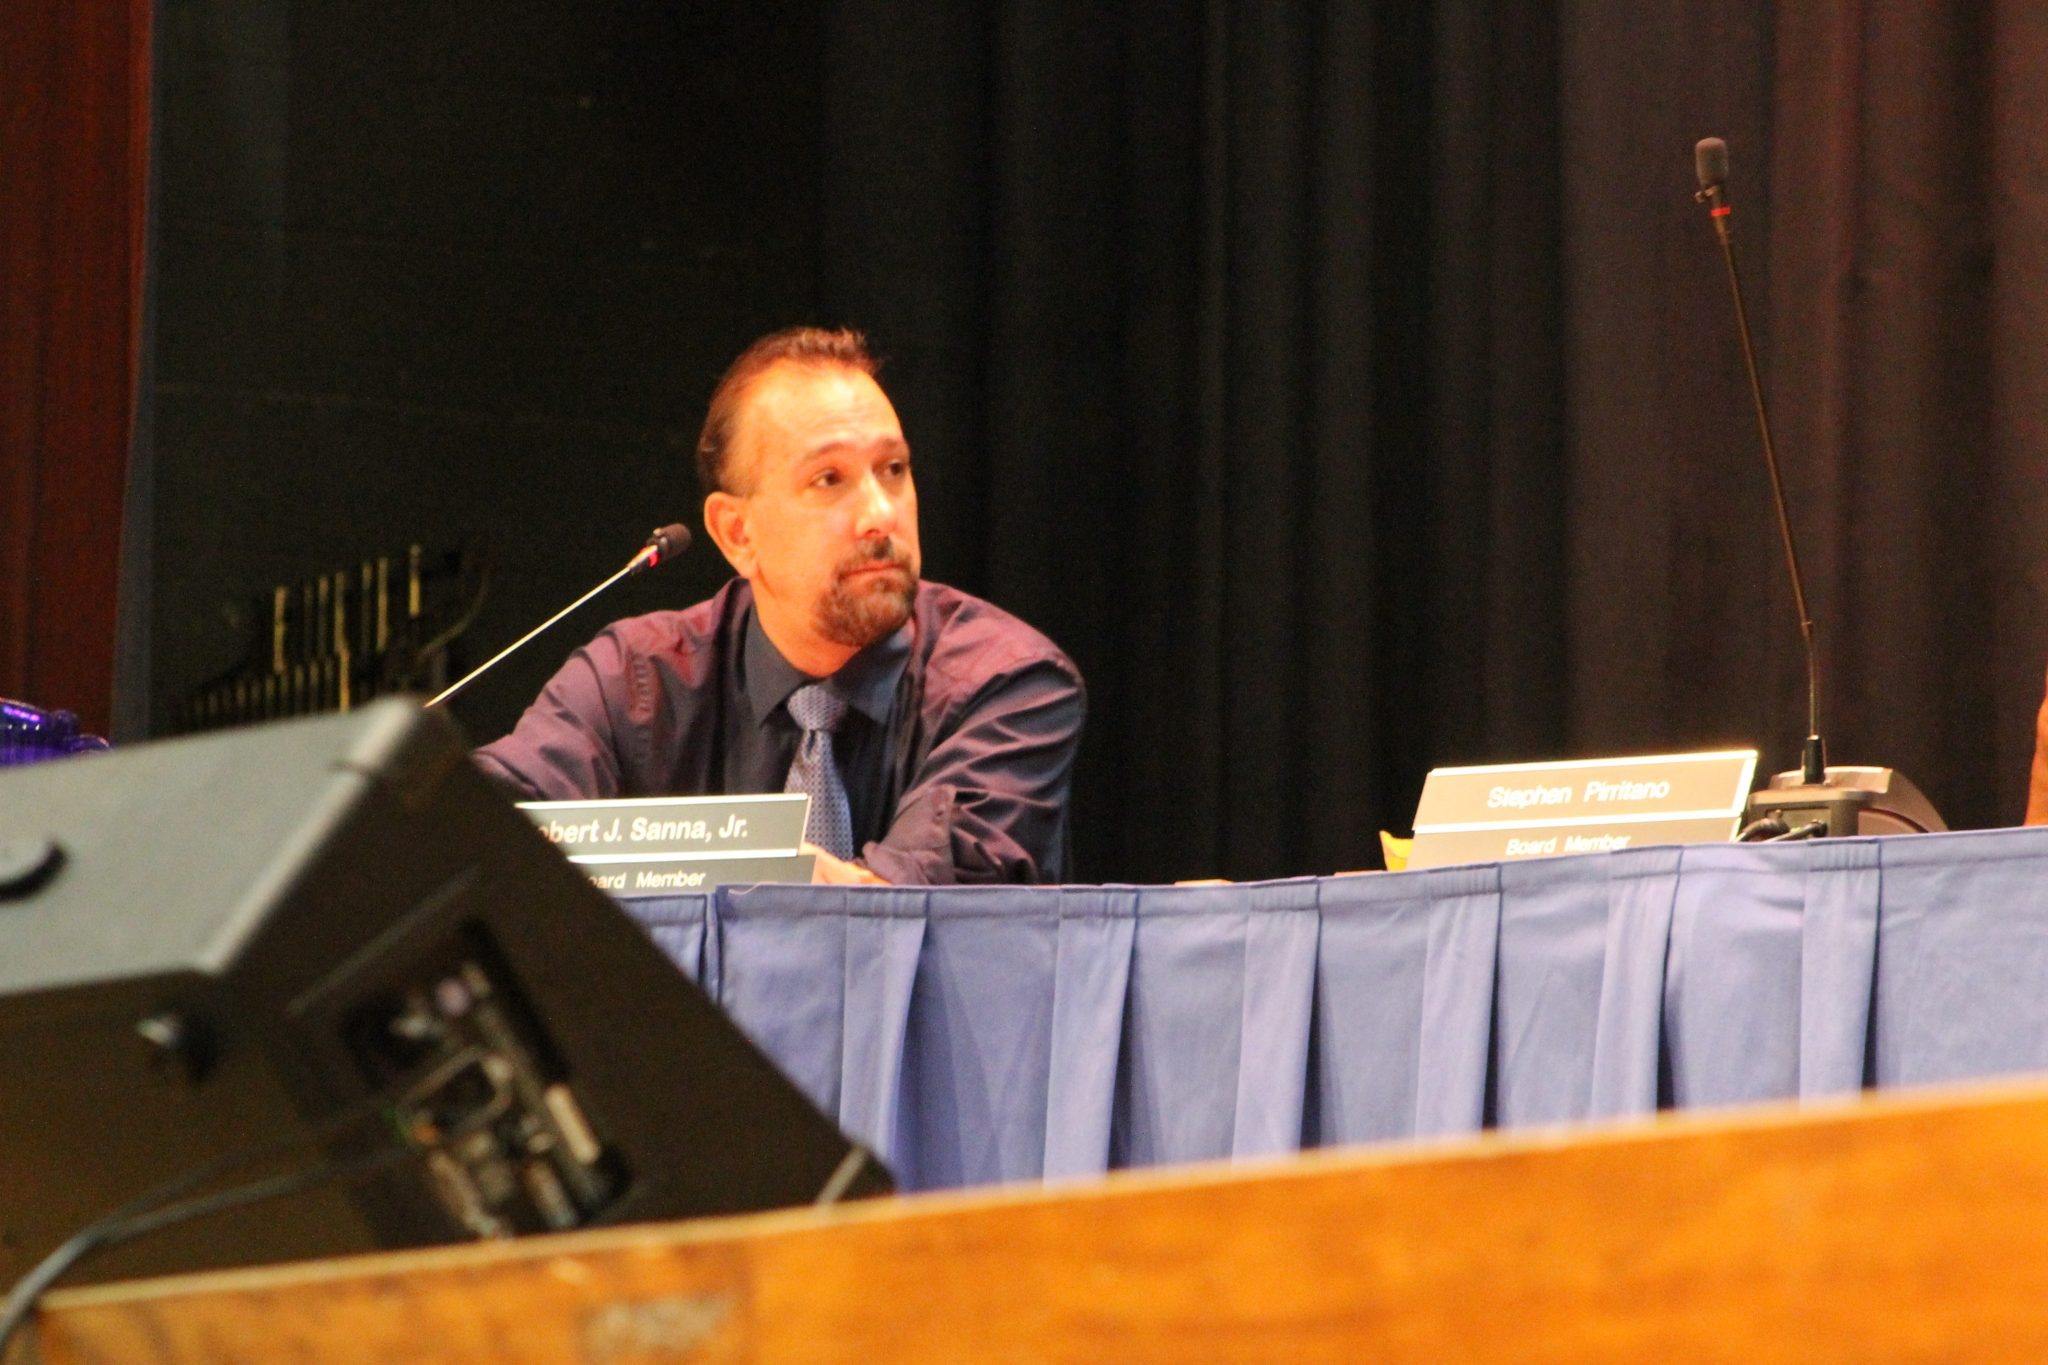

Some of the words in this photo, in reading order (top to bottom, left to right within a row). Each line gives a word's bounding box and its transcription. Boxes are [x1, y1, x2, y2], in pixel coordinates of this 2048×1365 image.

[537, 819, 600, 844] bert
[603, 818, 622, 843] J.
[630, 815, 713, 844] Sanna,
[719, 814, 749, 839] Jr.
[1505, 837, 1557, 856] Board
[1564, 834, 1631, 852] Member
[635, 870, 706, 889] Member
